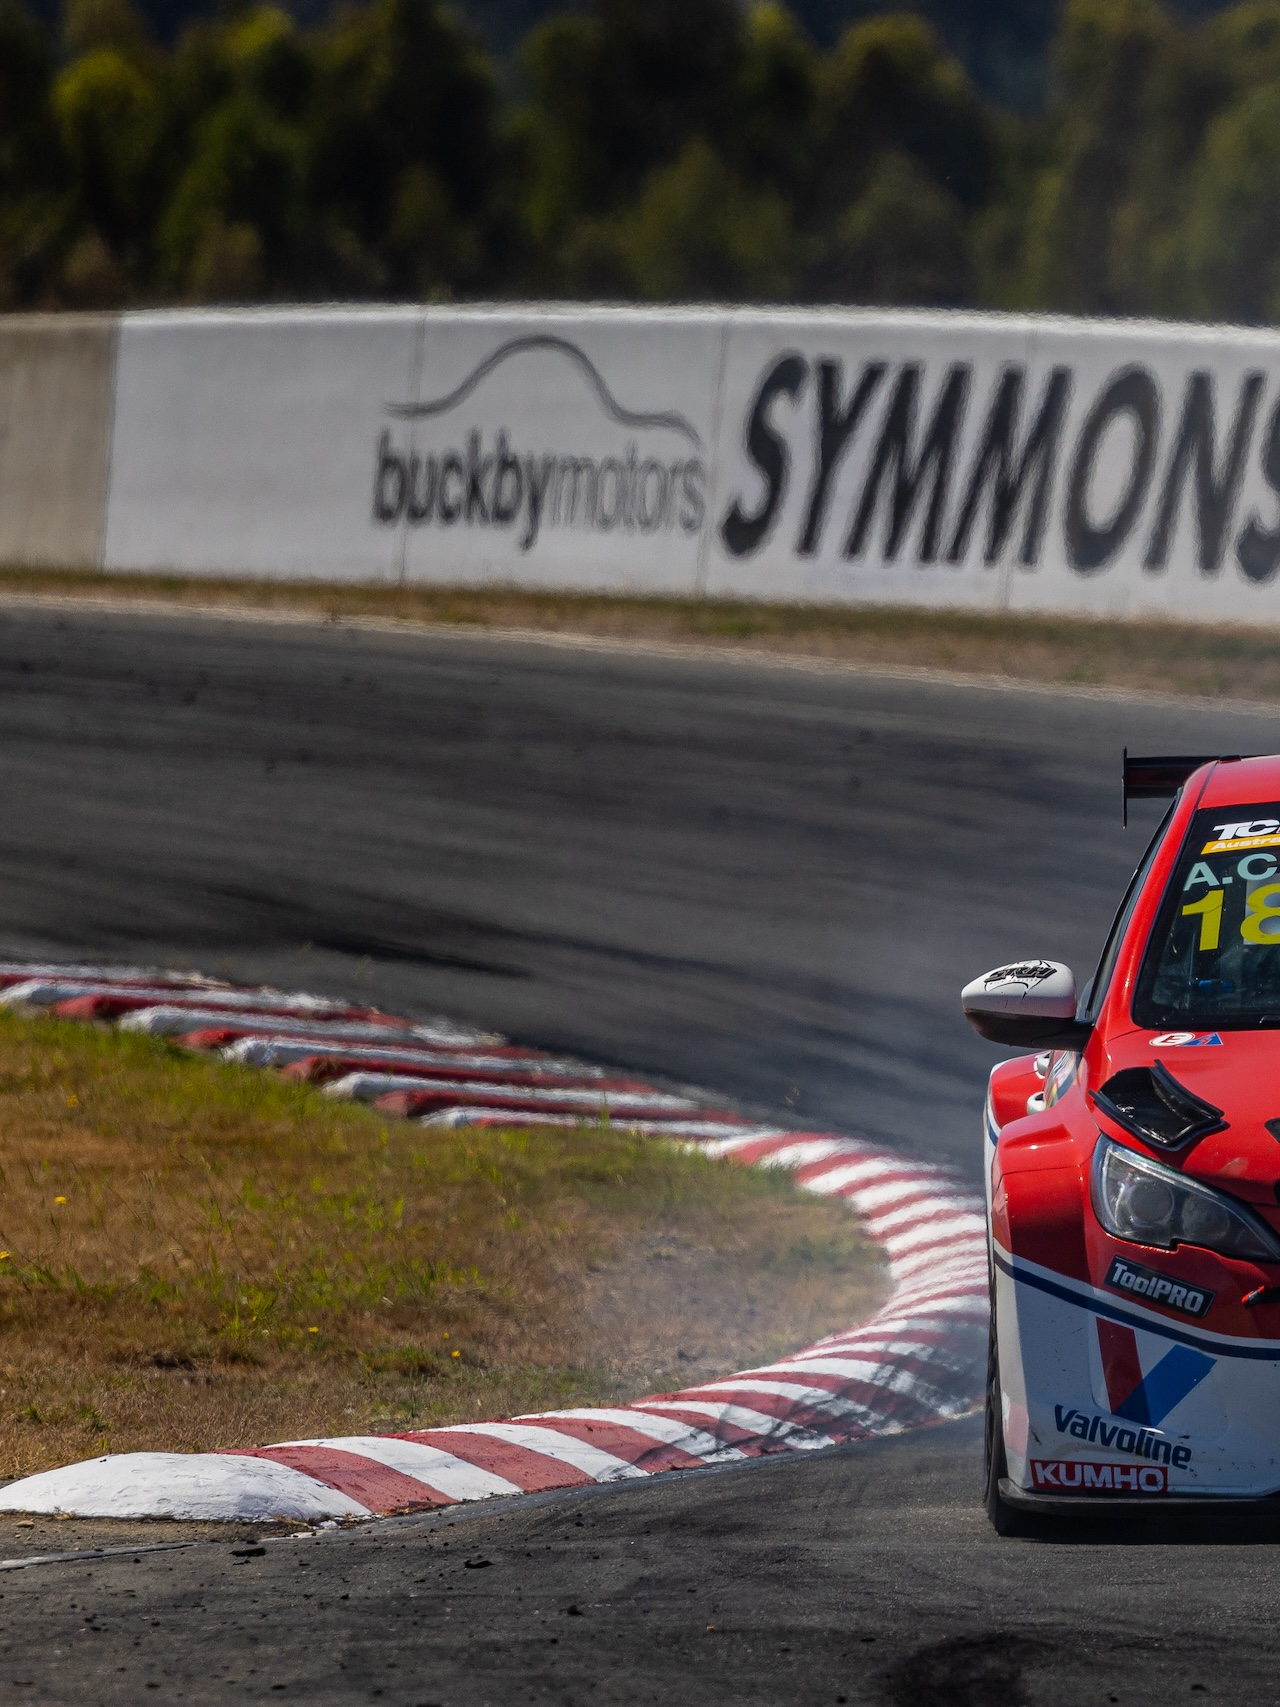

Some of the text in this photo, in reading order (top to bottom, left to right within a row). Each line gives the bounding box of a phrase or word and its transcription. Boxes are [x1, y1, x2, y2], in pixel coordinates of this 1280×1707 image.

[1112, 1261, 1205, 1314] ToolPRO
[1054, 1404, 1192, 1471] Valvoline
[1034, 1462, 1165, 1492] KUMHO
